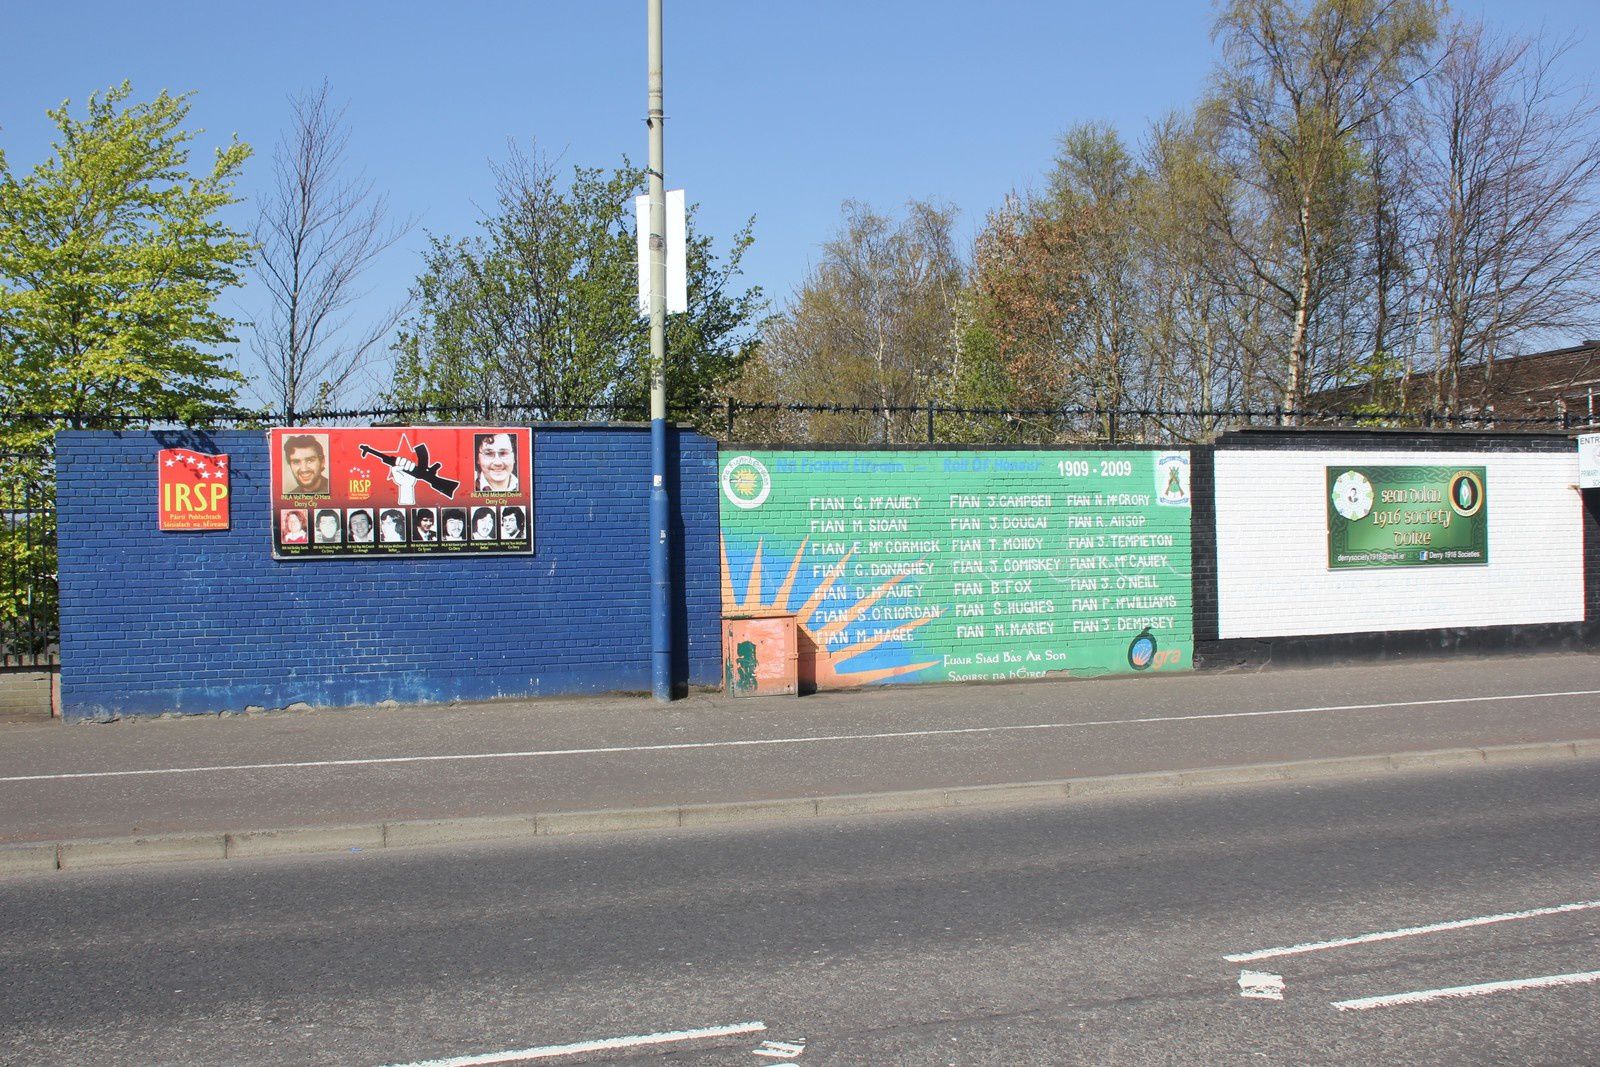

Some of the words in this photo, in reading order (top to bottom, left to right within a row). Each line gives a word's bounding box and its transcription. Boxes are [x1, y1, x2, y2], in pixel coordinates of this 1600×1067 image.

[1057, 460, 1089, 477] 1909
[1100, 460, 1132, 477] 2009
[349, 479, 371, 493] IRSP
[164, 483, 228, 511] IRSP
[949, 495, 980, 508] FIAN
[1067, 495, 1091, 506] FIAN
[810, 497, 845, 511] FIAN
[950, 518, 981, 530] FIAN
[1068, 516, 1092, 528] FIAN
[1372, 508, 1401, 529] 1916
[1404, 508, 1451, 529] society
[811, 520, 845, 533] FIAN
[812, 543, 845, 555] FIAN
[951, 539, 982, 552] FIAN
[1068, 537, 1094, 549] FIAN
[953, 560, 983, 574] FIAN
[1070, 557, 1096, 569] FIAN
[813, 564, 846, 578] FIAN
[954, 583, 983, 596] FIAN
[1071, 579, 1097, 591] FIAN
[814, 586, 847, 600] FIAN
[955, 603, 984, 617] FIAN
[1072, 599, 1098, 612] FIAN
[815, 609, 848, 623] FIAN
[956, 625, 985, 639] FIAN
[1073, 620, 1099, 633] FIAN
[816, 631, 849, 645] FIAN
[975, 652, 999, 664] Siad
[1045, 649, 1066, 661] Son
[992, 672, 1006, 680] na
